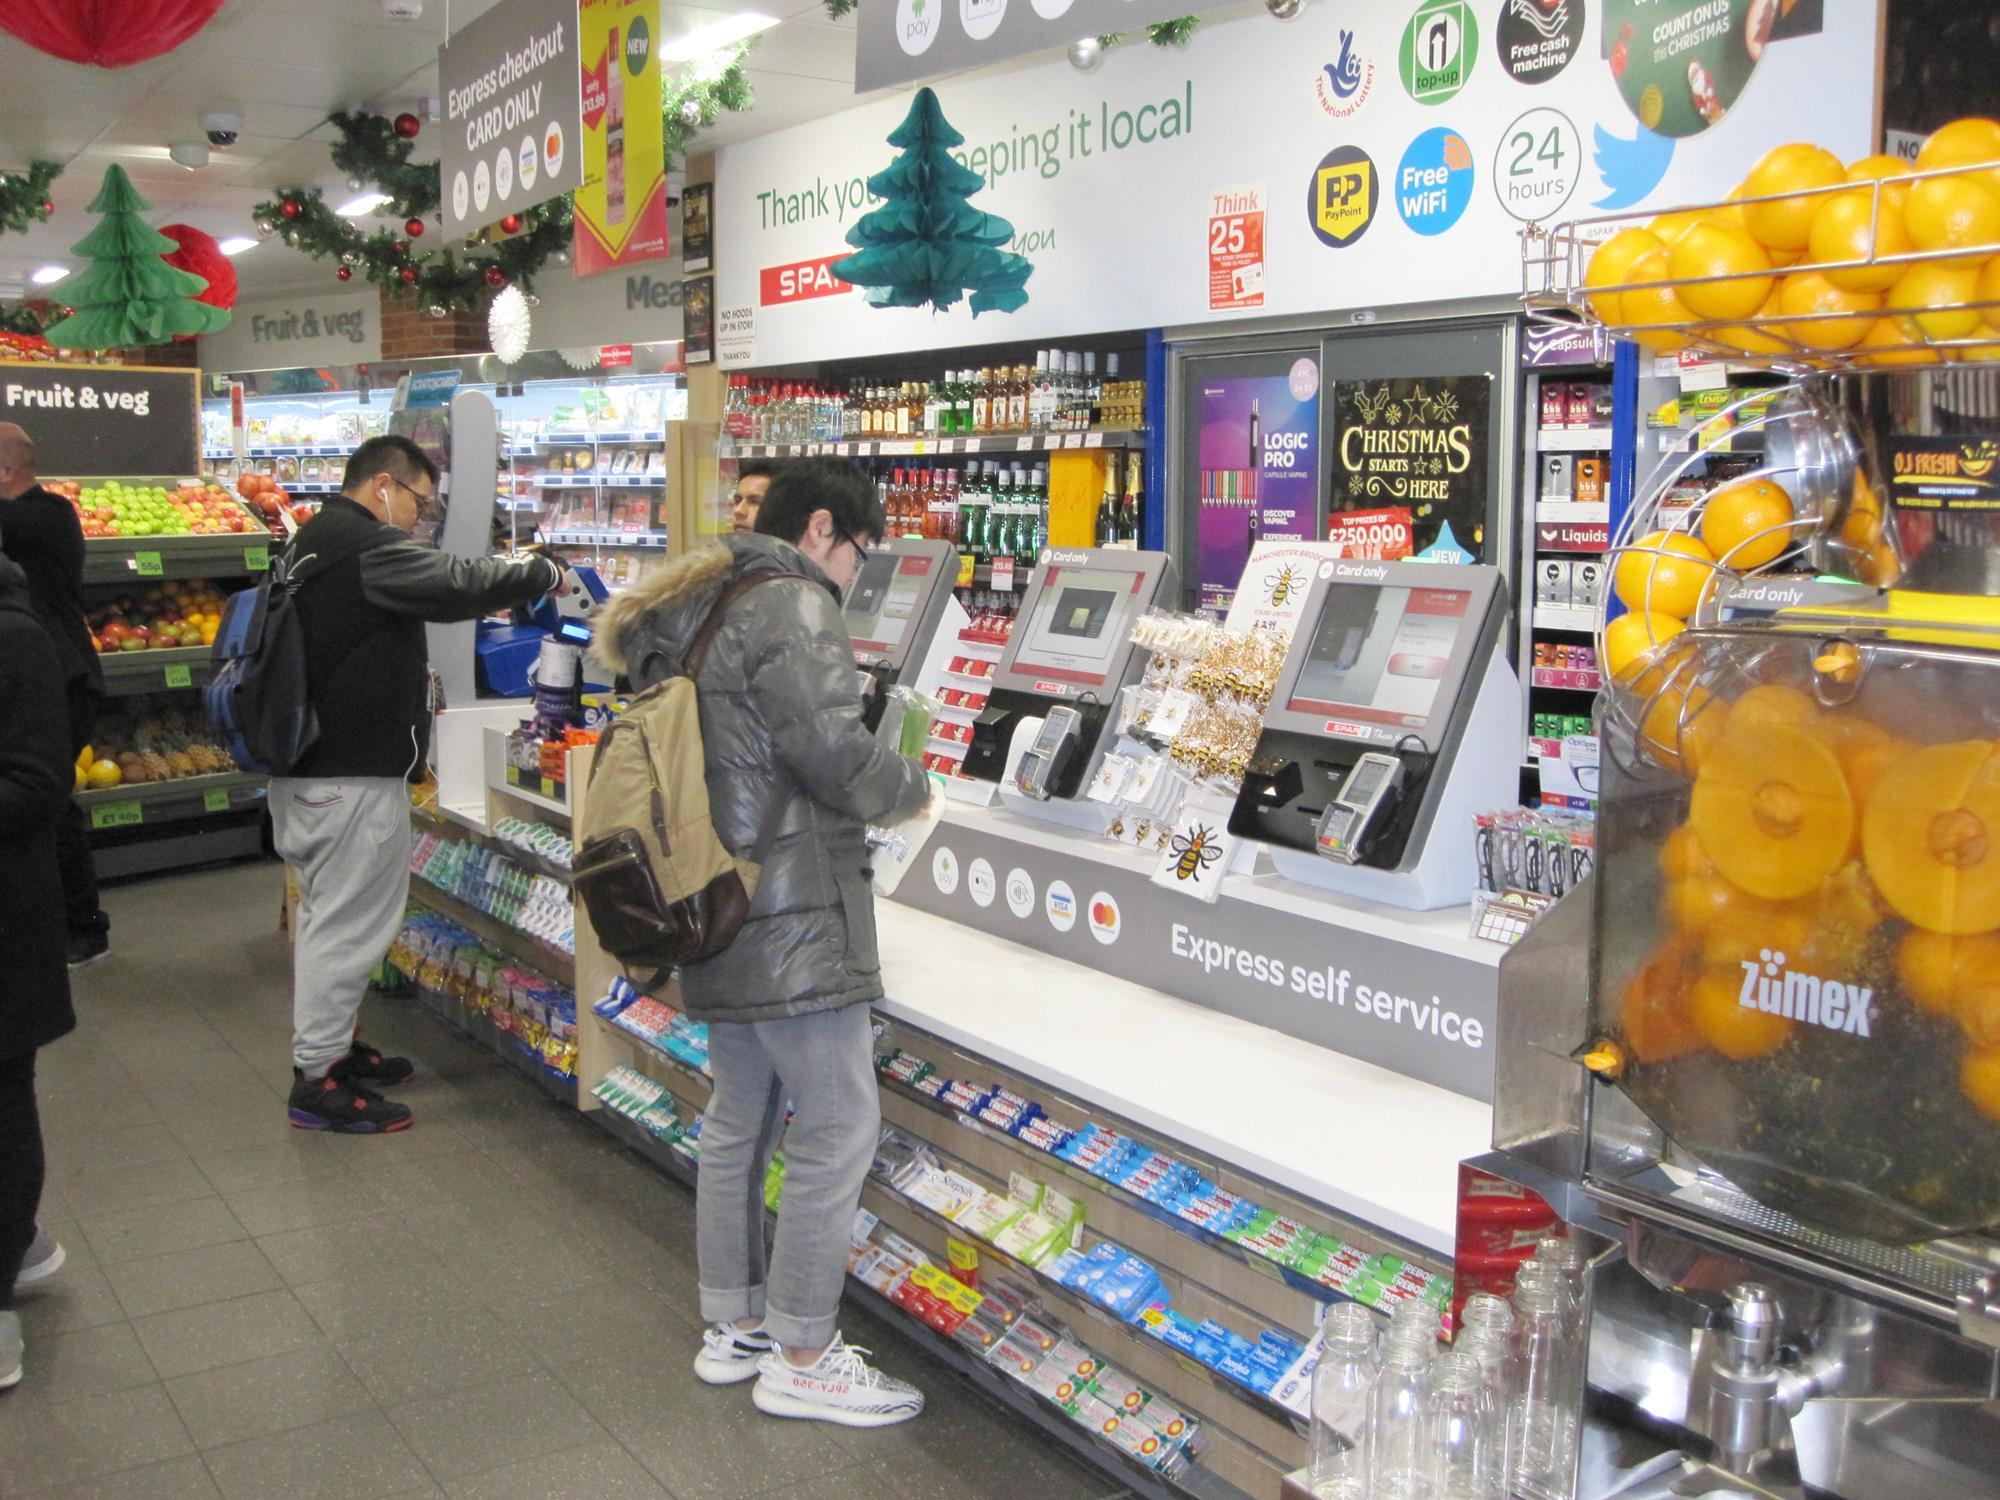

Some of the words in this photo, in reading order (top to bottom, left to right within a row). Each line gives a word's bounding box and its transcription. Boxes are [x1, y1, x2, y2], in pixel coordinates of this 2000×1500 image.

[907, 19, 930, 39] pay
[1652, 10, 1692, 44] COUNT
[1693, 4, 1713, 26] ON
[1713, 0, 1730, 18] US
[627, 36, 649, 55] NEW
[1511, 43, 1537, 60] Free
[1539, 34, 1570, 53] cash
[1668, 16, 1730, 56] CHRISTMAS
[449, 70, 497, 120] Express
[499, 21, 564, 89] checkout
[1513, 52, 1567, 74] machine
[1316, 75, 1324, 98] The
[1321, 96, 1355, 118] National
[1355, 64, 1375, 107] Lottery
[1416, 70, 1459, 90] top-up
[467, 106, 502, 151] CARD
[505, 81, 542, 130] ONLY
[757, 176, 829, 229] Thank
[953, 123, 1061, 189] eping
[1068, 107, 1092, 159] it
[1101, 79, 1192, 152] local
[1509, 126, 1565, 176] 24
[1402, 166, 1449, 190] Free
[1508, 178, 1564, 201] hours
[1214, 190, 1258, 215] Think
[1325, 206, 1363, 221] PayPoint
[1402, 189, 1447, 218] WiFi
[1211, 218, 1245, 255] 25
[780, 263, 838, 297] SPA
[721, 309, 731, 319] NO
[252, 311, 299, 343] Fruit
[300, 309, 320, 338] &
[323, 310, 365, 343] veg
[720, 322, 729, 332] UP
[729, 322, 736, 331] IN
[737, 320, 753, 330] STORE
[723, 351, 751, 360] THANKYOU
[6, 384, 74, 409] Fruit
[79, 387, 99, 409] &
[103, 390, 150, 416] veg
[1264, 432, 1308, 450] LOGIC
[1341, 425, 1470, 473] CHRISTMAS
[1264, 451, 1295, 467] PRO
[1368, 459, 1409, 473] STARTS
[1915, 453, 1959, 475] FRESH
[1410, 480, 1449, 500] HERE
[1263, 510, 1296, 518] DISCOVER
[1342, 517, 1355, 526] TOP
[1355, 516, 1377, 525] PRIZES
[1378, 515, 1388, 523] OF
[1329, 524, 1406, 546] £250,000
[1562, 529, 1608, 544] Liquids
[1053, 551, 1072, 563] Card
[1072, 553, 1089, 566] only
[1252, 549, 1298, 563] MANCHESTER
[1299, 550, 1326, 561] BROOC
[1432, 550, 1461, 564] NEW
[1336, 564, 1362, 578] Card
[1363, 567, 1388, 581] only
[1727, 585, 1765, 602] Card
[1768, 586, 1804, 605] only
[1333, 724, 1360, 735] SPAR
[1054, 901, 1069, 912] VISA
[1171, 923, 1285, 987] Express
[1290, 966, 1351, 1006] self
[1354, 985, 1484, 1048] service
[1339, 1243, 1371, 1263] TREBOR
[1325, 1257, 1361, 1279] TREBOR
[1399, 1261, 1436, 1284] TREBOR
[1390, 1274, 1428, 1298] TREBOR
